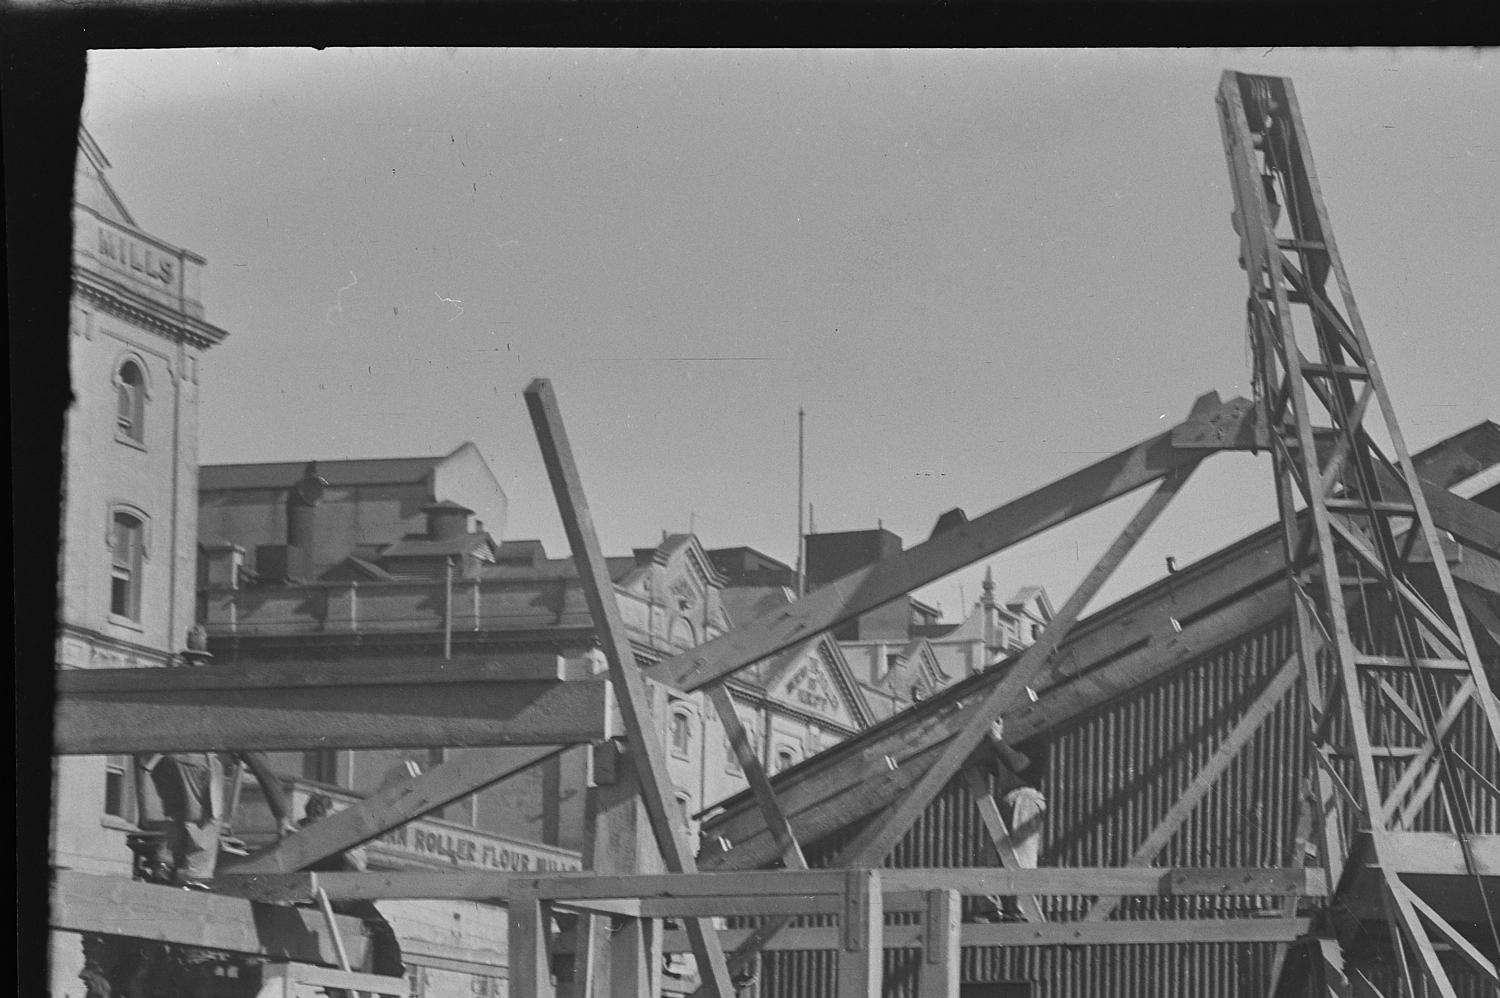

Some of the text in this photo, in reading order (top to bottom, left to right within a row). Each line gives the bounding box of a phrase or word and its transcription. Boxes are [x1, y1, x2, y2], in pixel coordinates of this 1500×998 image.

[98, 227, 175, 284] MILLS
[415, 829, 476, 862] ROLLER
[482, 845, 530, 871] FLOUR
